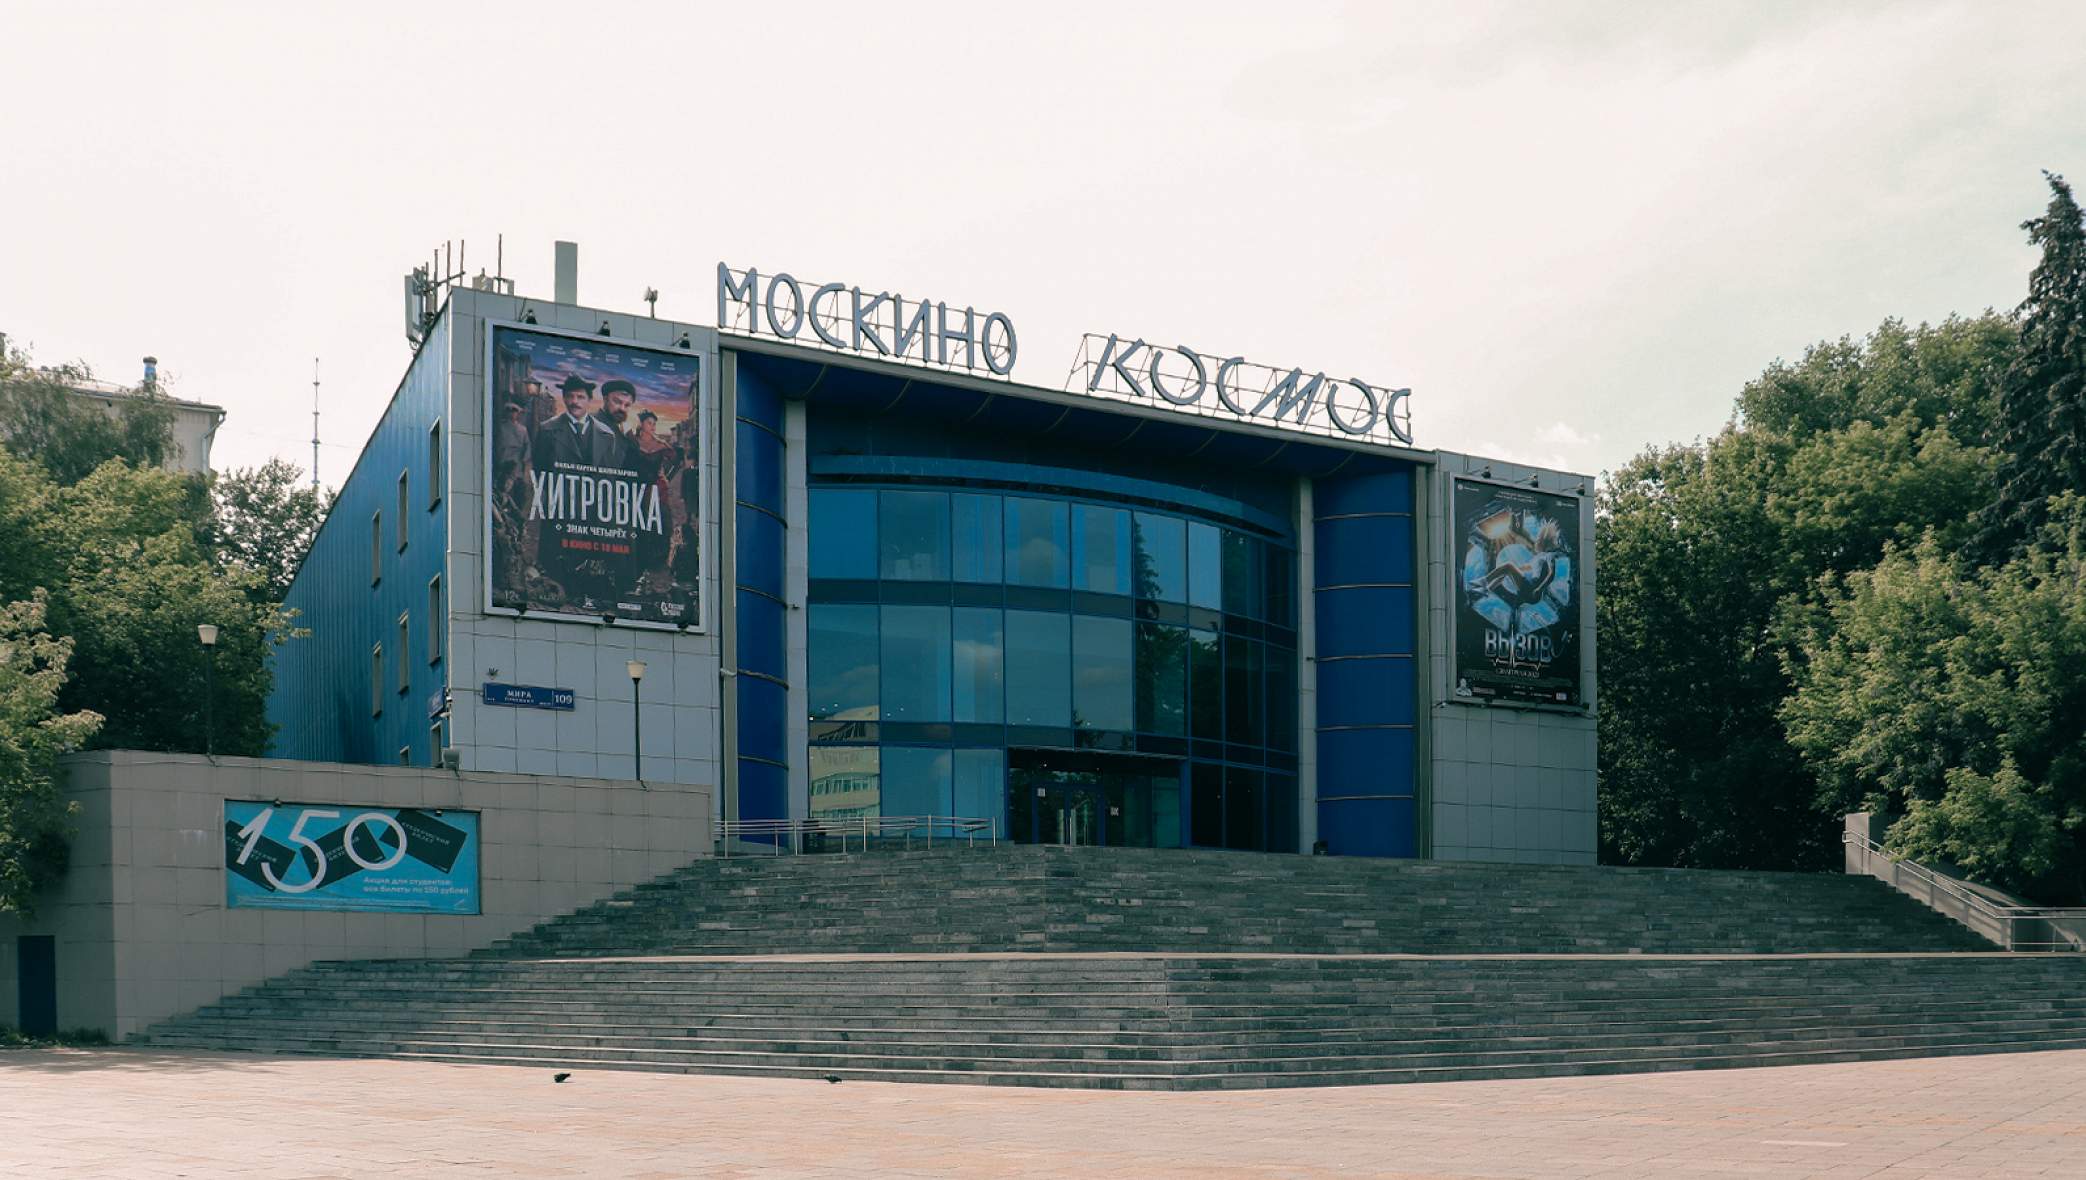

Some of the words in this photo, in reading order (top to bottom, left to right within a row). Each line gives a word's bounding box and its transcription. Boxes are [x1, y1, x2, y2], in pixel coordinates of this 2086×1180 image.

[718, 261, 1017, 375] МОСКИНО
[1090, 333, 1412, 444] КОСМОС
[529, 469, 662, 535] ХИТРОВКА
[566, 523, 588, 535] ЗНАК
[589, 526, 627, 539] ЧЕТЫРЁХ
[507, 690, 532, 699] МИРА
[554, 694, 573, 704] 109
[237, 807, 407, 893] 150
